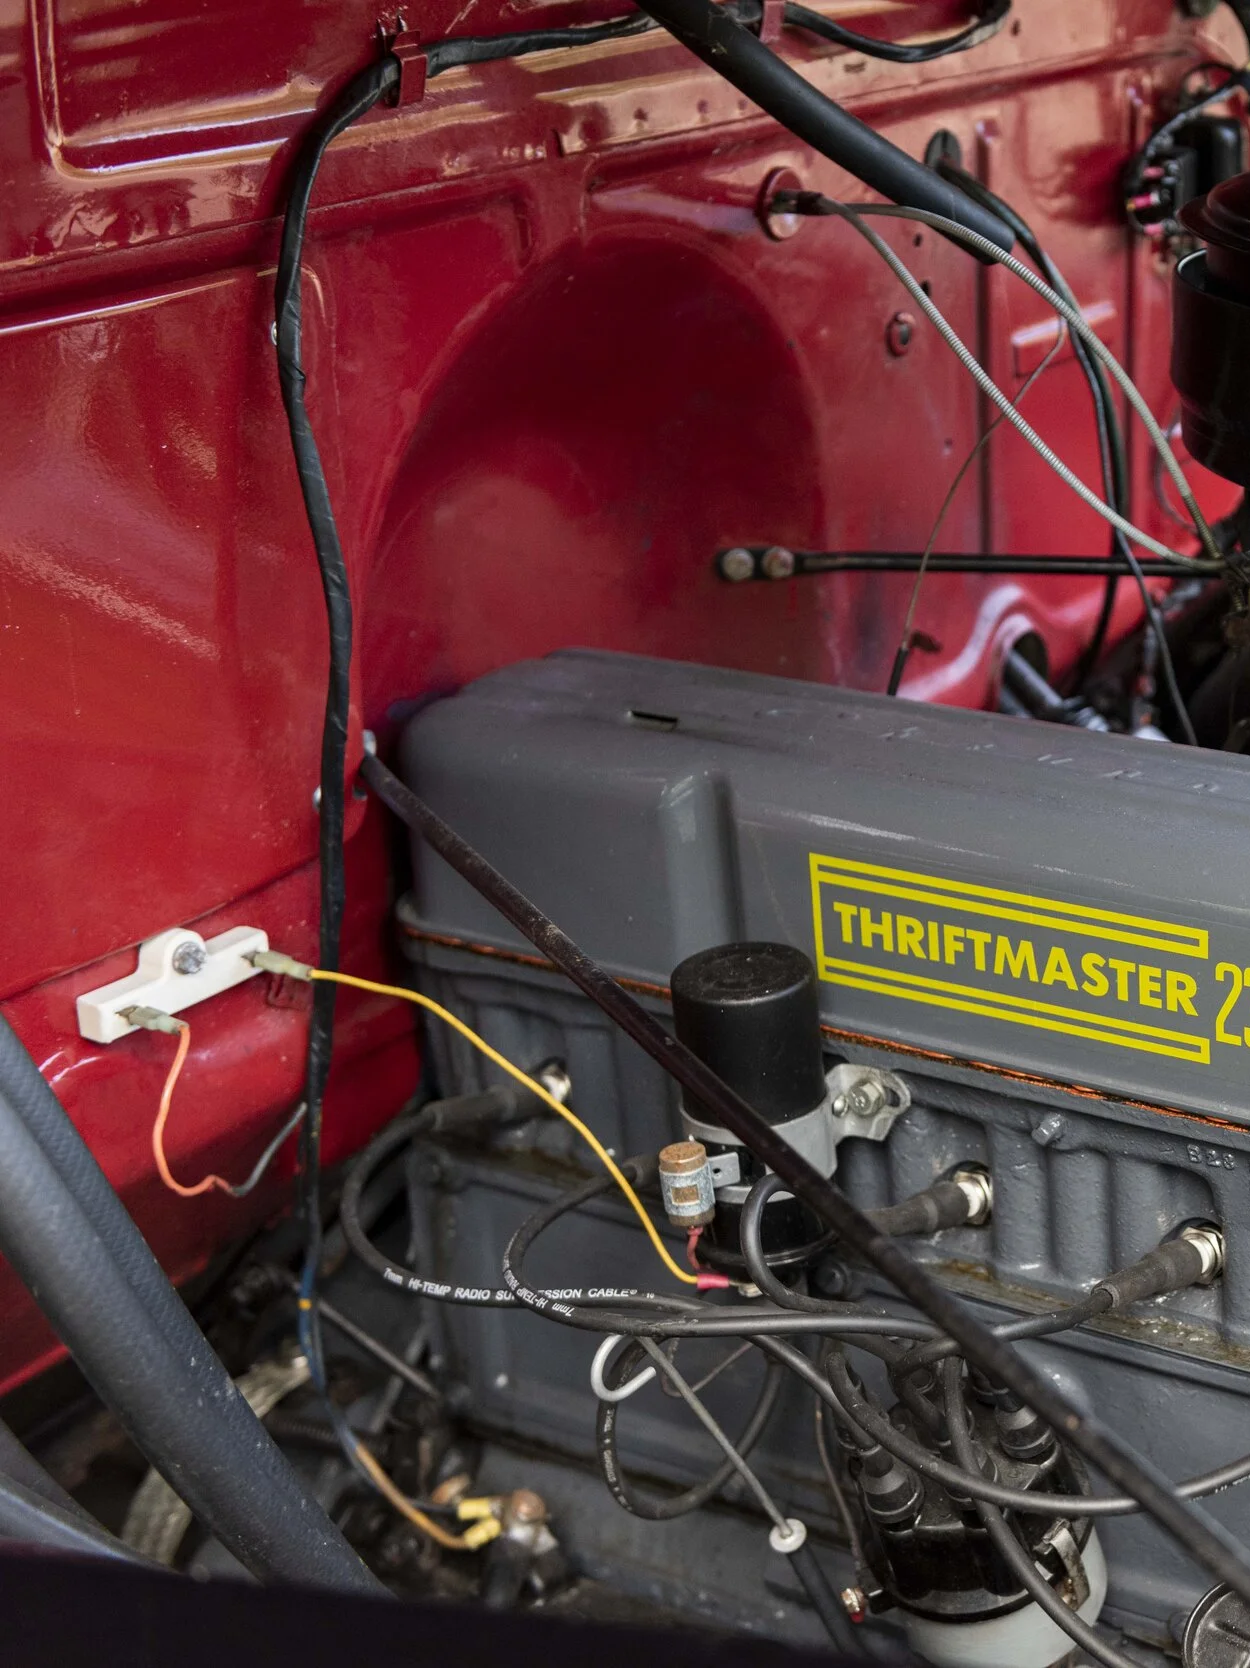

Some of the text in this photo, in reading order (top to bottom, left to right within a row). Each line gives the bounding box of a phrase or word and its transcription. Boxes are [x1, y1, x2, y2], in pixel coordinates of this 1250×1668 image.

[832, 901, 1199, 1016] THRIFTMASTER
[383, 1267, 403, 1285] 7mm
[408, 1277, 452, 1297] HI-TEMP
[454, 1287, 491, 1300] RADIO
[516, 1286, 549, 1309] HI-TEMP
[551, 1302, 575, 1317] 7mm
